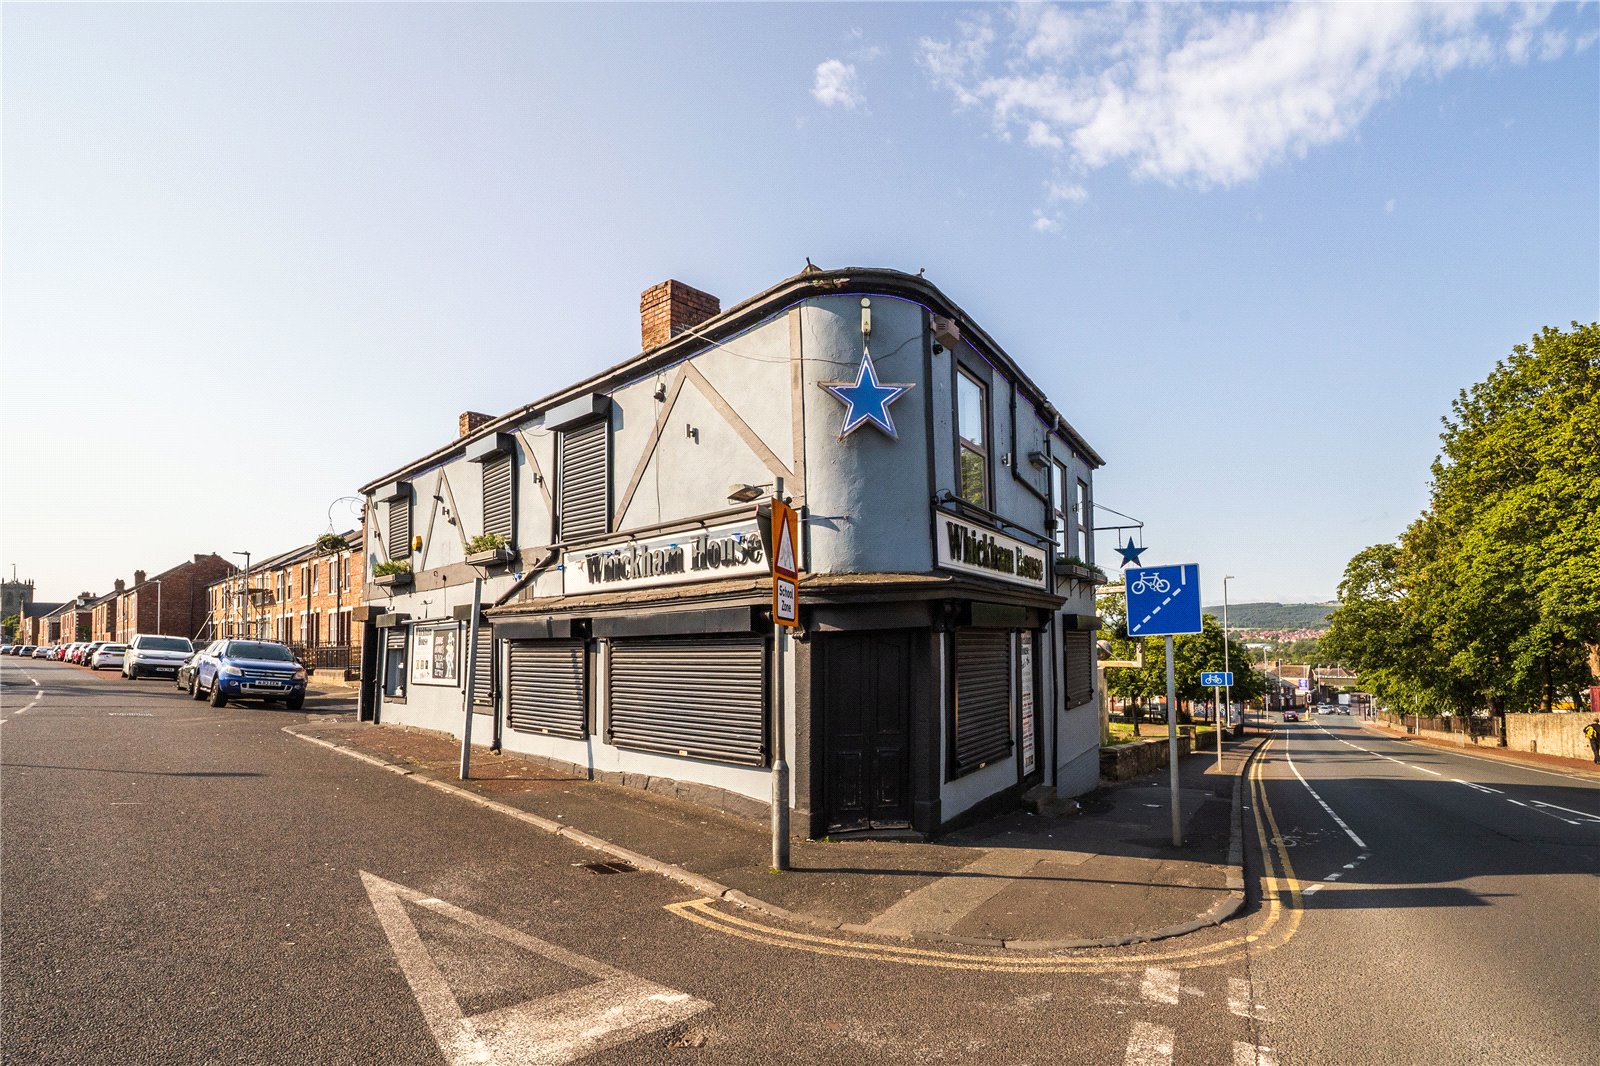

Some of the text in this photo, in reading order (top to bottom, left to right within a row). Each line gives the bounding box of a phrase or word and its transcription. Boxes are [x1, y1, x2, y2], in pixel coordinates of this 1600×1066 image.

[585, 532, 764, 584] Whickham House
[946, 521, 1014, 575] Whickham
[779, 585, 794, 600] School
[781, 600, 792, 613] Zone
